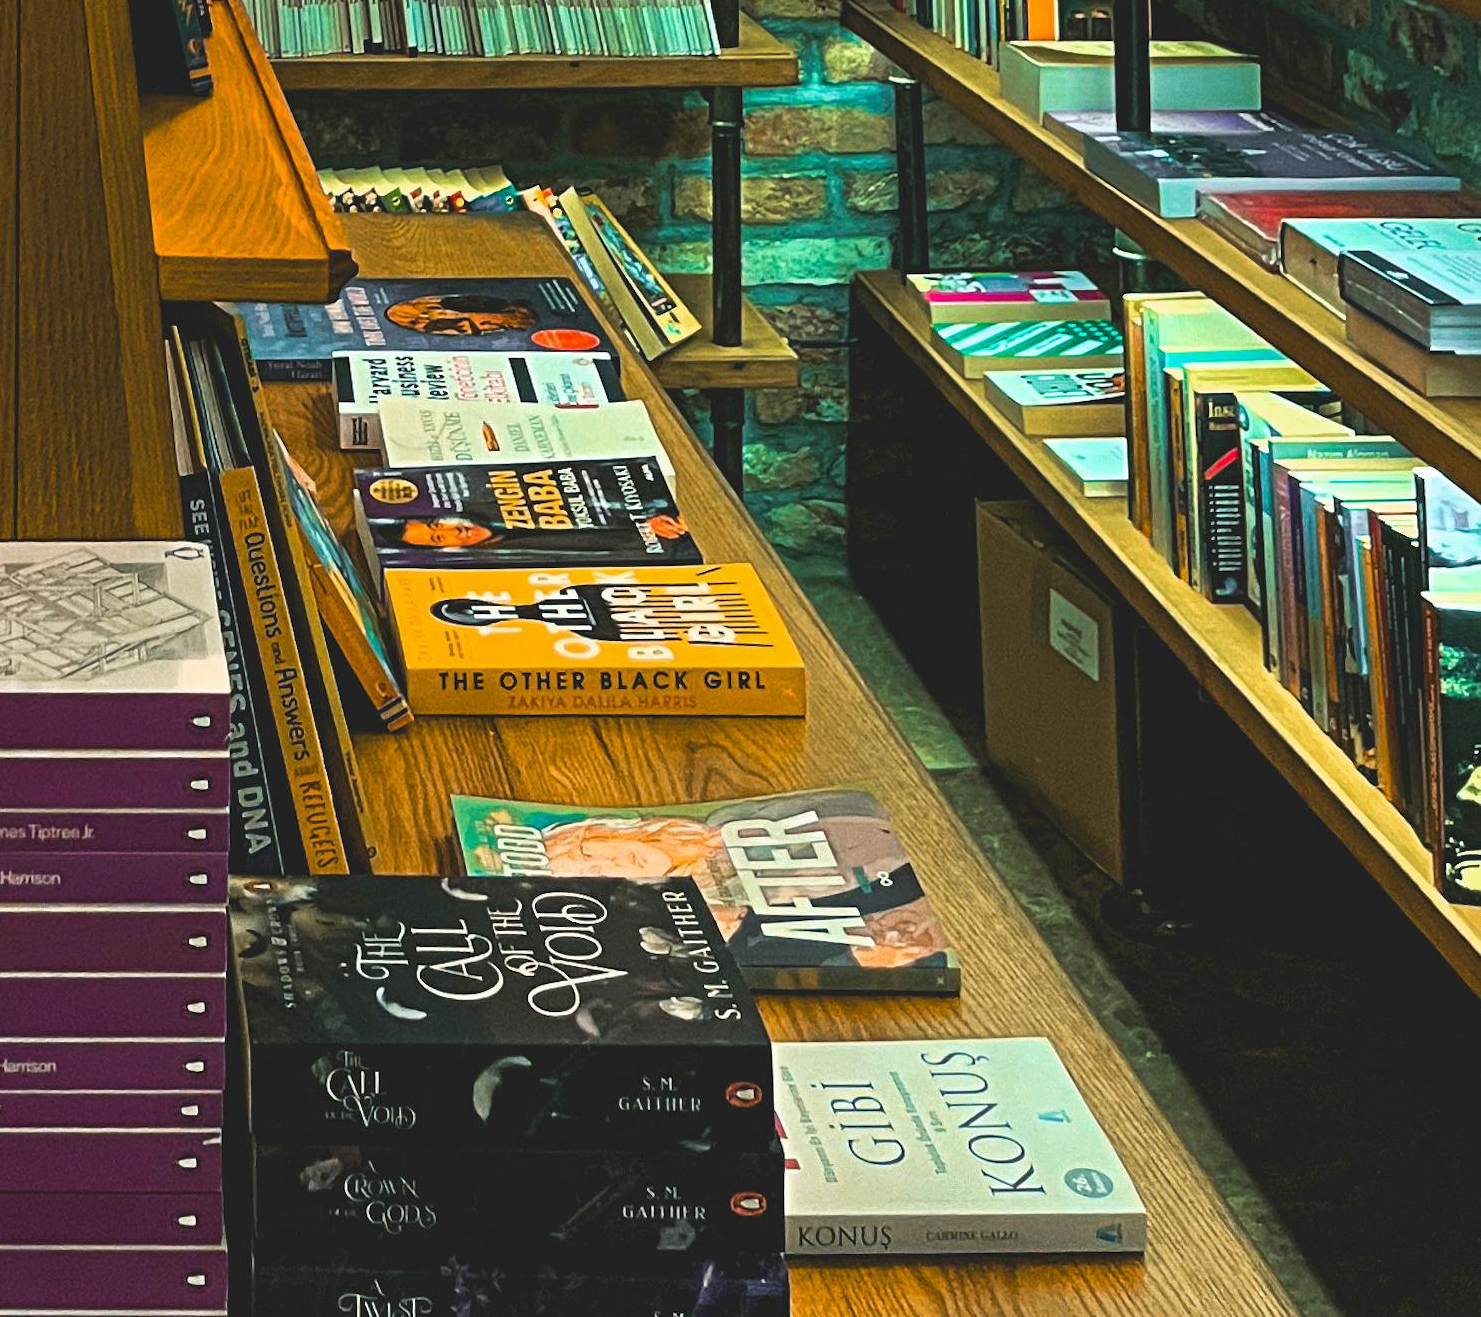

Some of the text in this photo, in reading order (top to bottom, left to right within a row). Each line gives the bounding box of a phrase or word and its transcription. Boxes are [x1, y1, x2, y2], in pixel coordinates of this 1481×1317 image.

[189, 498, 211, 536] SEE
[486, 470, 536, 530] ZENGİN
[522, 469, 574, 530] BABA
[244, 531, 282, 640] Questions
[465, 590, 524, 637] THE
[527, 572, 603, 660] OTHER
[270, 641, 285, 666] and
[438, 670, 767, 691] THE OTHER BLACK GIRL
[274, 666, 310, 762] Answers
[507, 695, 568, 710] ZAKIYA
[229, 724, 260, 781] and
[28, 823, 81, 842] Tiptree
[237, 785, 272, 856] DNA
[0, 870, 61, 886] Harrison
[721, 810, 877, 947] AFTER
[356, 921, 409, 981] THE
[410, 919, 504, 1001] CALL
[485, 898, 542, 979] OF THE
[527, 891, 629, 1018] VOID
[660, 890, 742, 1022] S. M. GAITHER
[618, 1096, 702, 1113] GAITHER
[641, 1077, 656, 1092] S.
[810, 1080, 907, 1166] GİBİ
[920, 1050, 1048, 1198] KONUŞ
[343, 1172, 419, 1202] CROWN
[622, 1204, 707, 1220] GAITHER
[797, 1225, 893, 1251] KONUŞ
